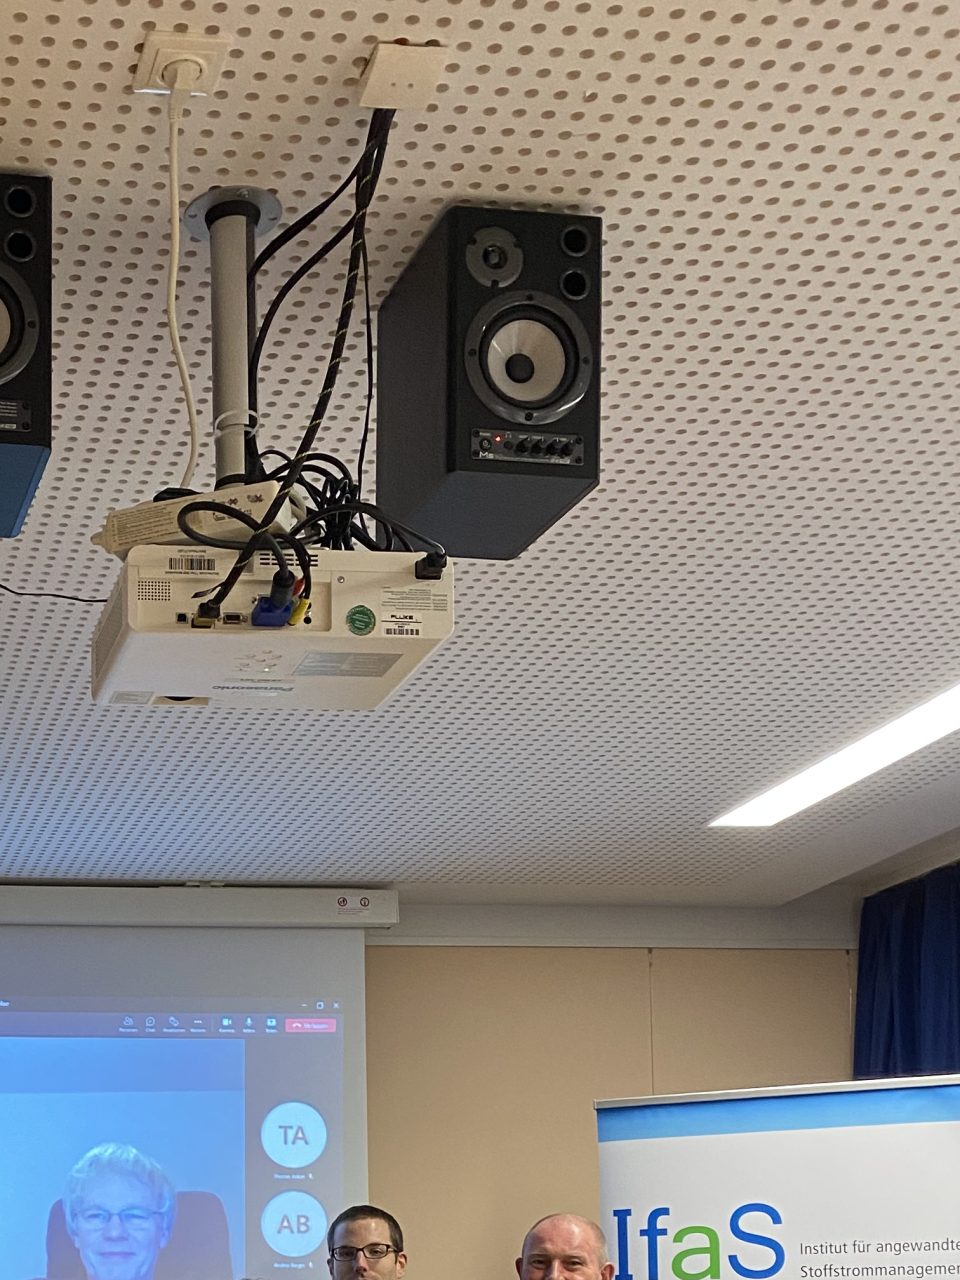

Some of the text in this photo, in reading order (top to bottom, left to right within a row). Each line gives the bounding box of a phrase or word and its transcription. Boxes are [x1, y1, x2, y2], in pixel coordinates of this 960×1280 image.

[278, 1125, 310, 1146] TA
[276, 1214, 310, 1235] AB
[800, 1238, 960, 1255] Institut für angewandte
